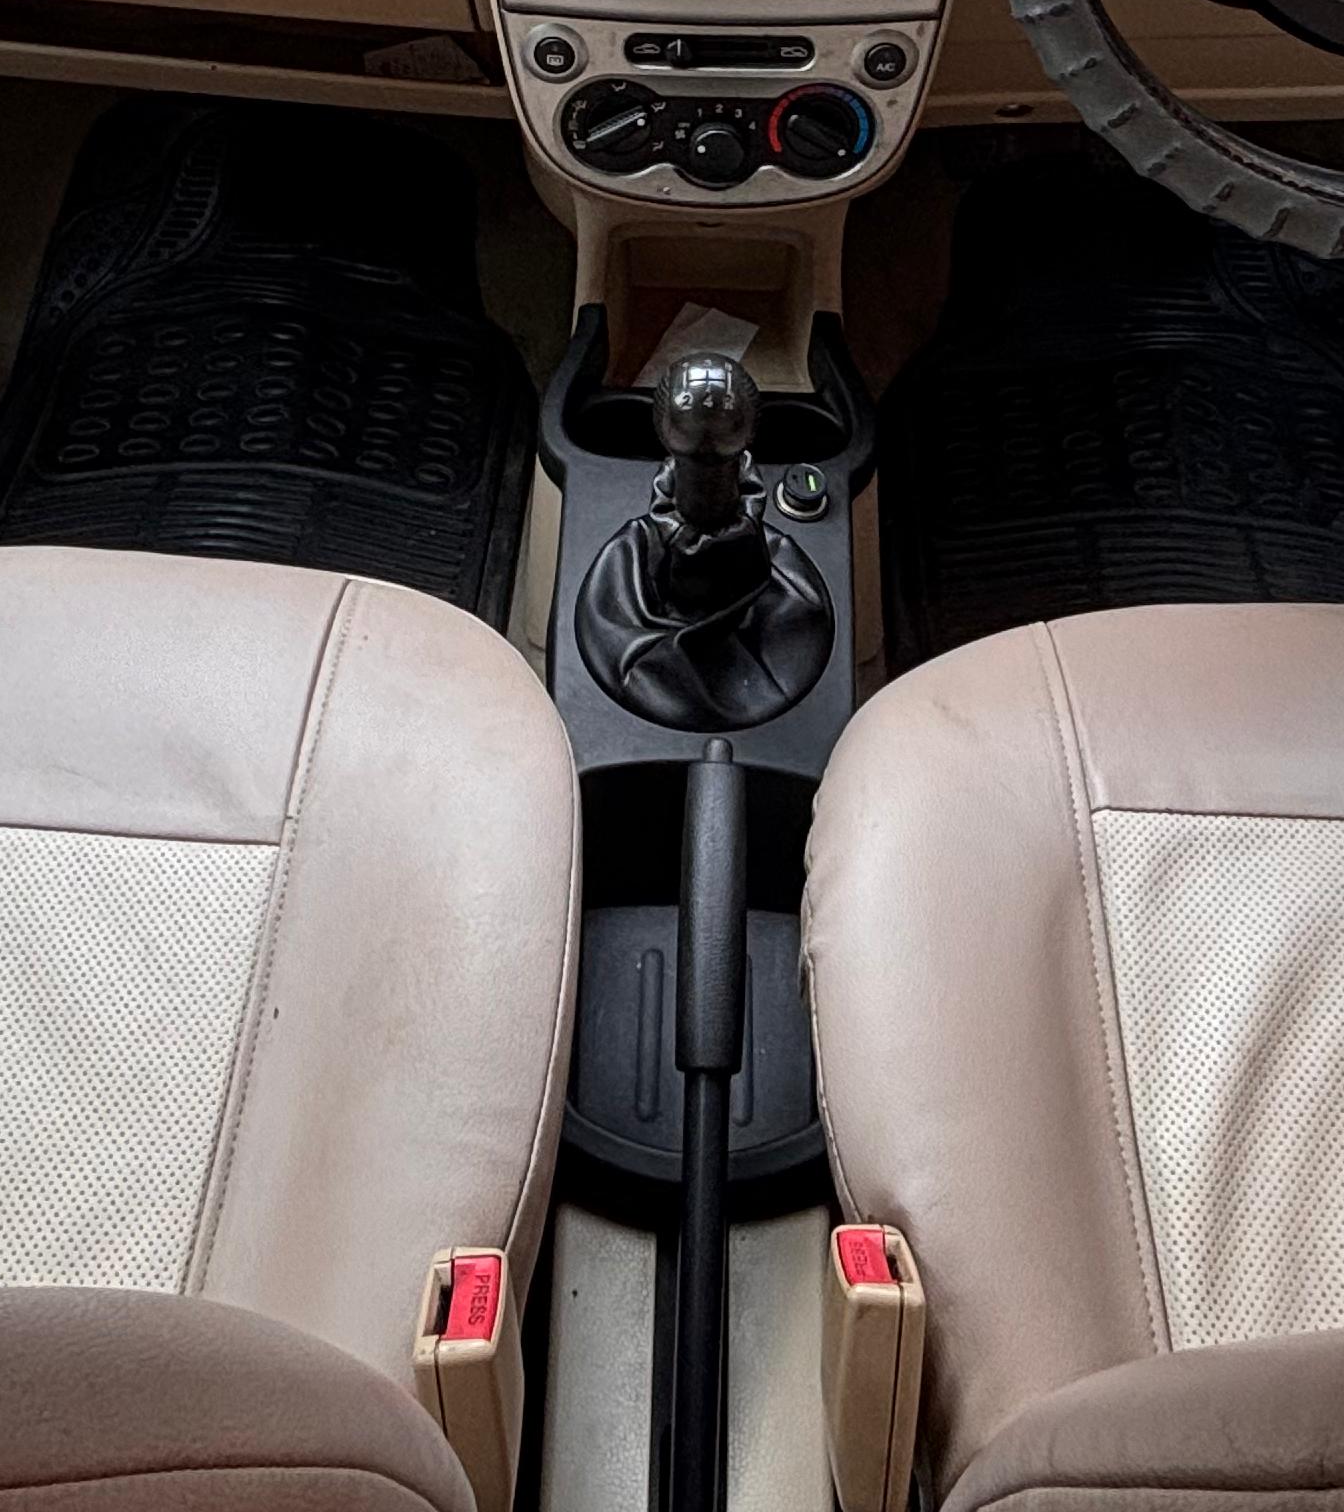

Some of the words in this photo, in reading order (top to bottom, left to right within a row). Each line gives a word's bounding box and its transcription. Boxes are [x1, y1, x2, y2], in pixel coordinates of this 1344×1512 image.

[876, 62, 896, 72] A/C
[715, 104, 724, 114] 2
[735, 108, 743, 119] 3
[748, 120, 756, 131] 4
[468, 1274, 491, 1326] PRESS
